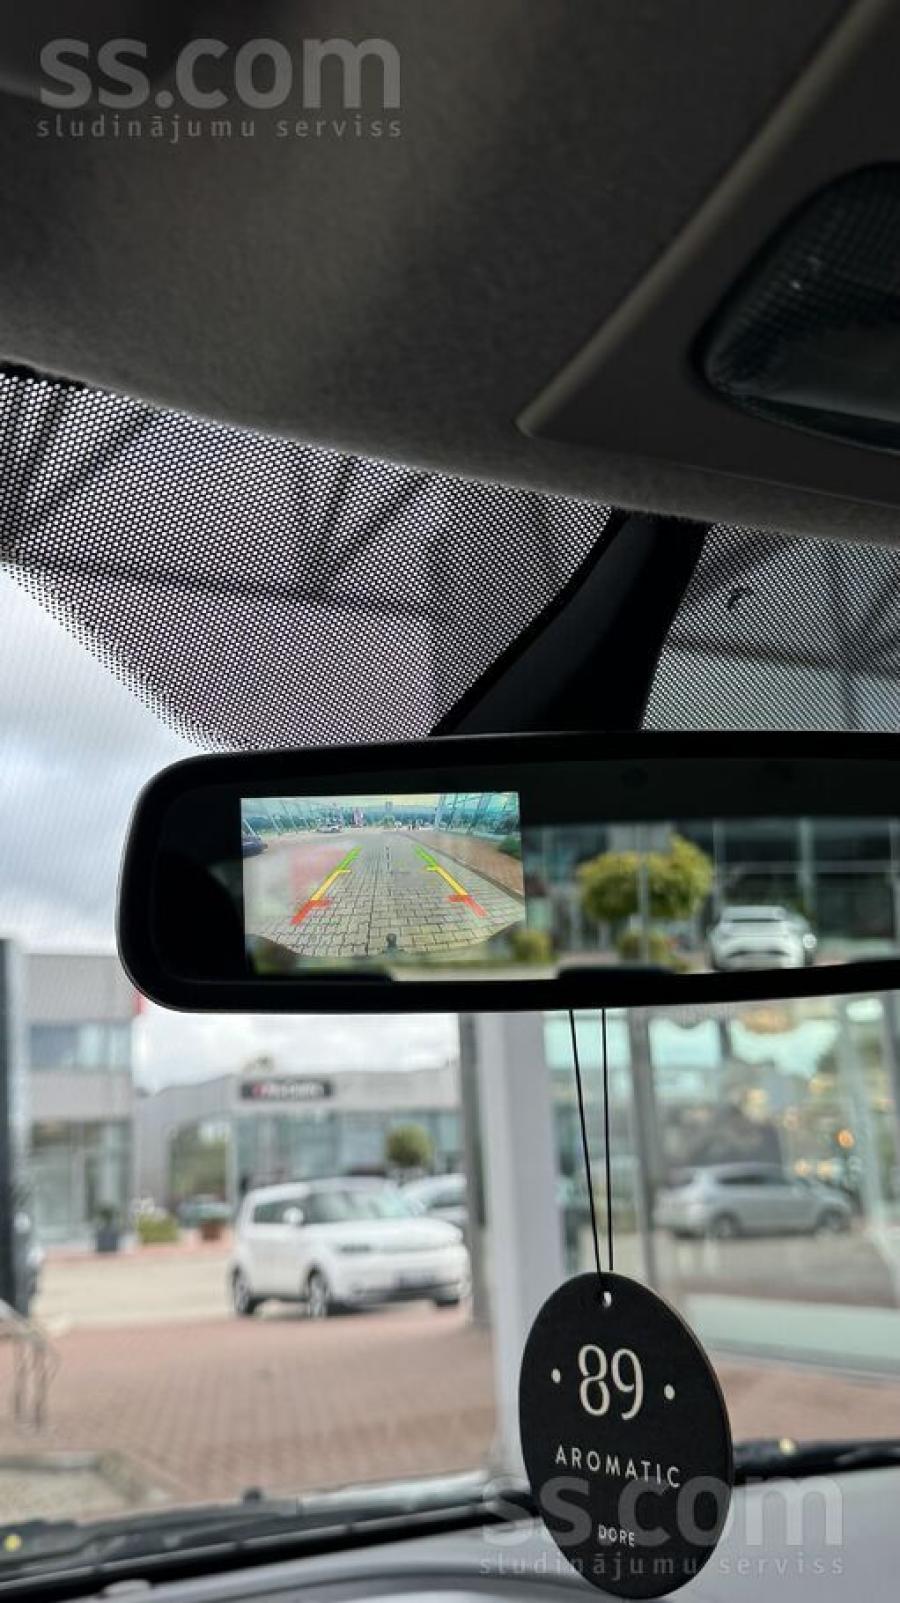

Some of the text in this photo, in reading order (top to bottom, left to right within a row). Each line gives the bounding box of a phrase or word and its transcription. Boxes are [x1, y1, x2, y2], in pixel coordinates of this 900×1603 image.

[577, 1343, 644, 1421] 89
[554, 1444, 681, 1489] AROMATIC
[597, 1524, 636, 1548] DORE
